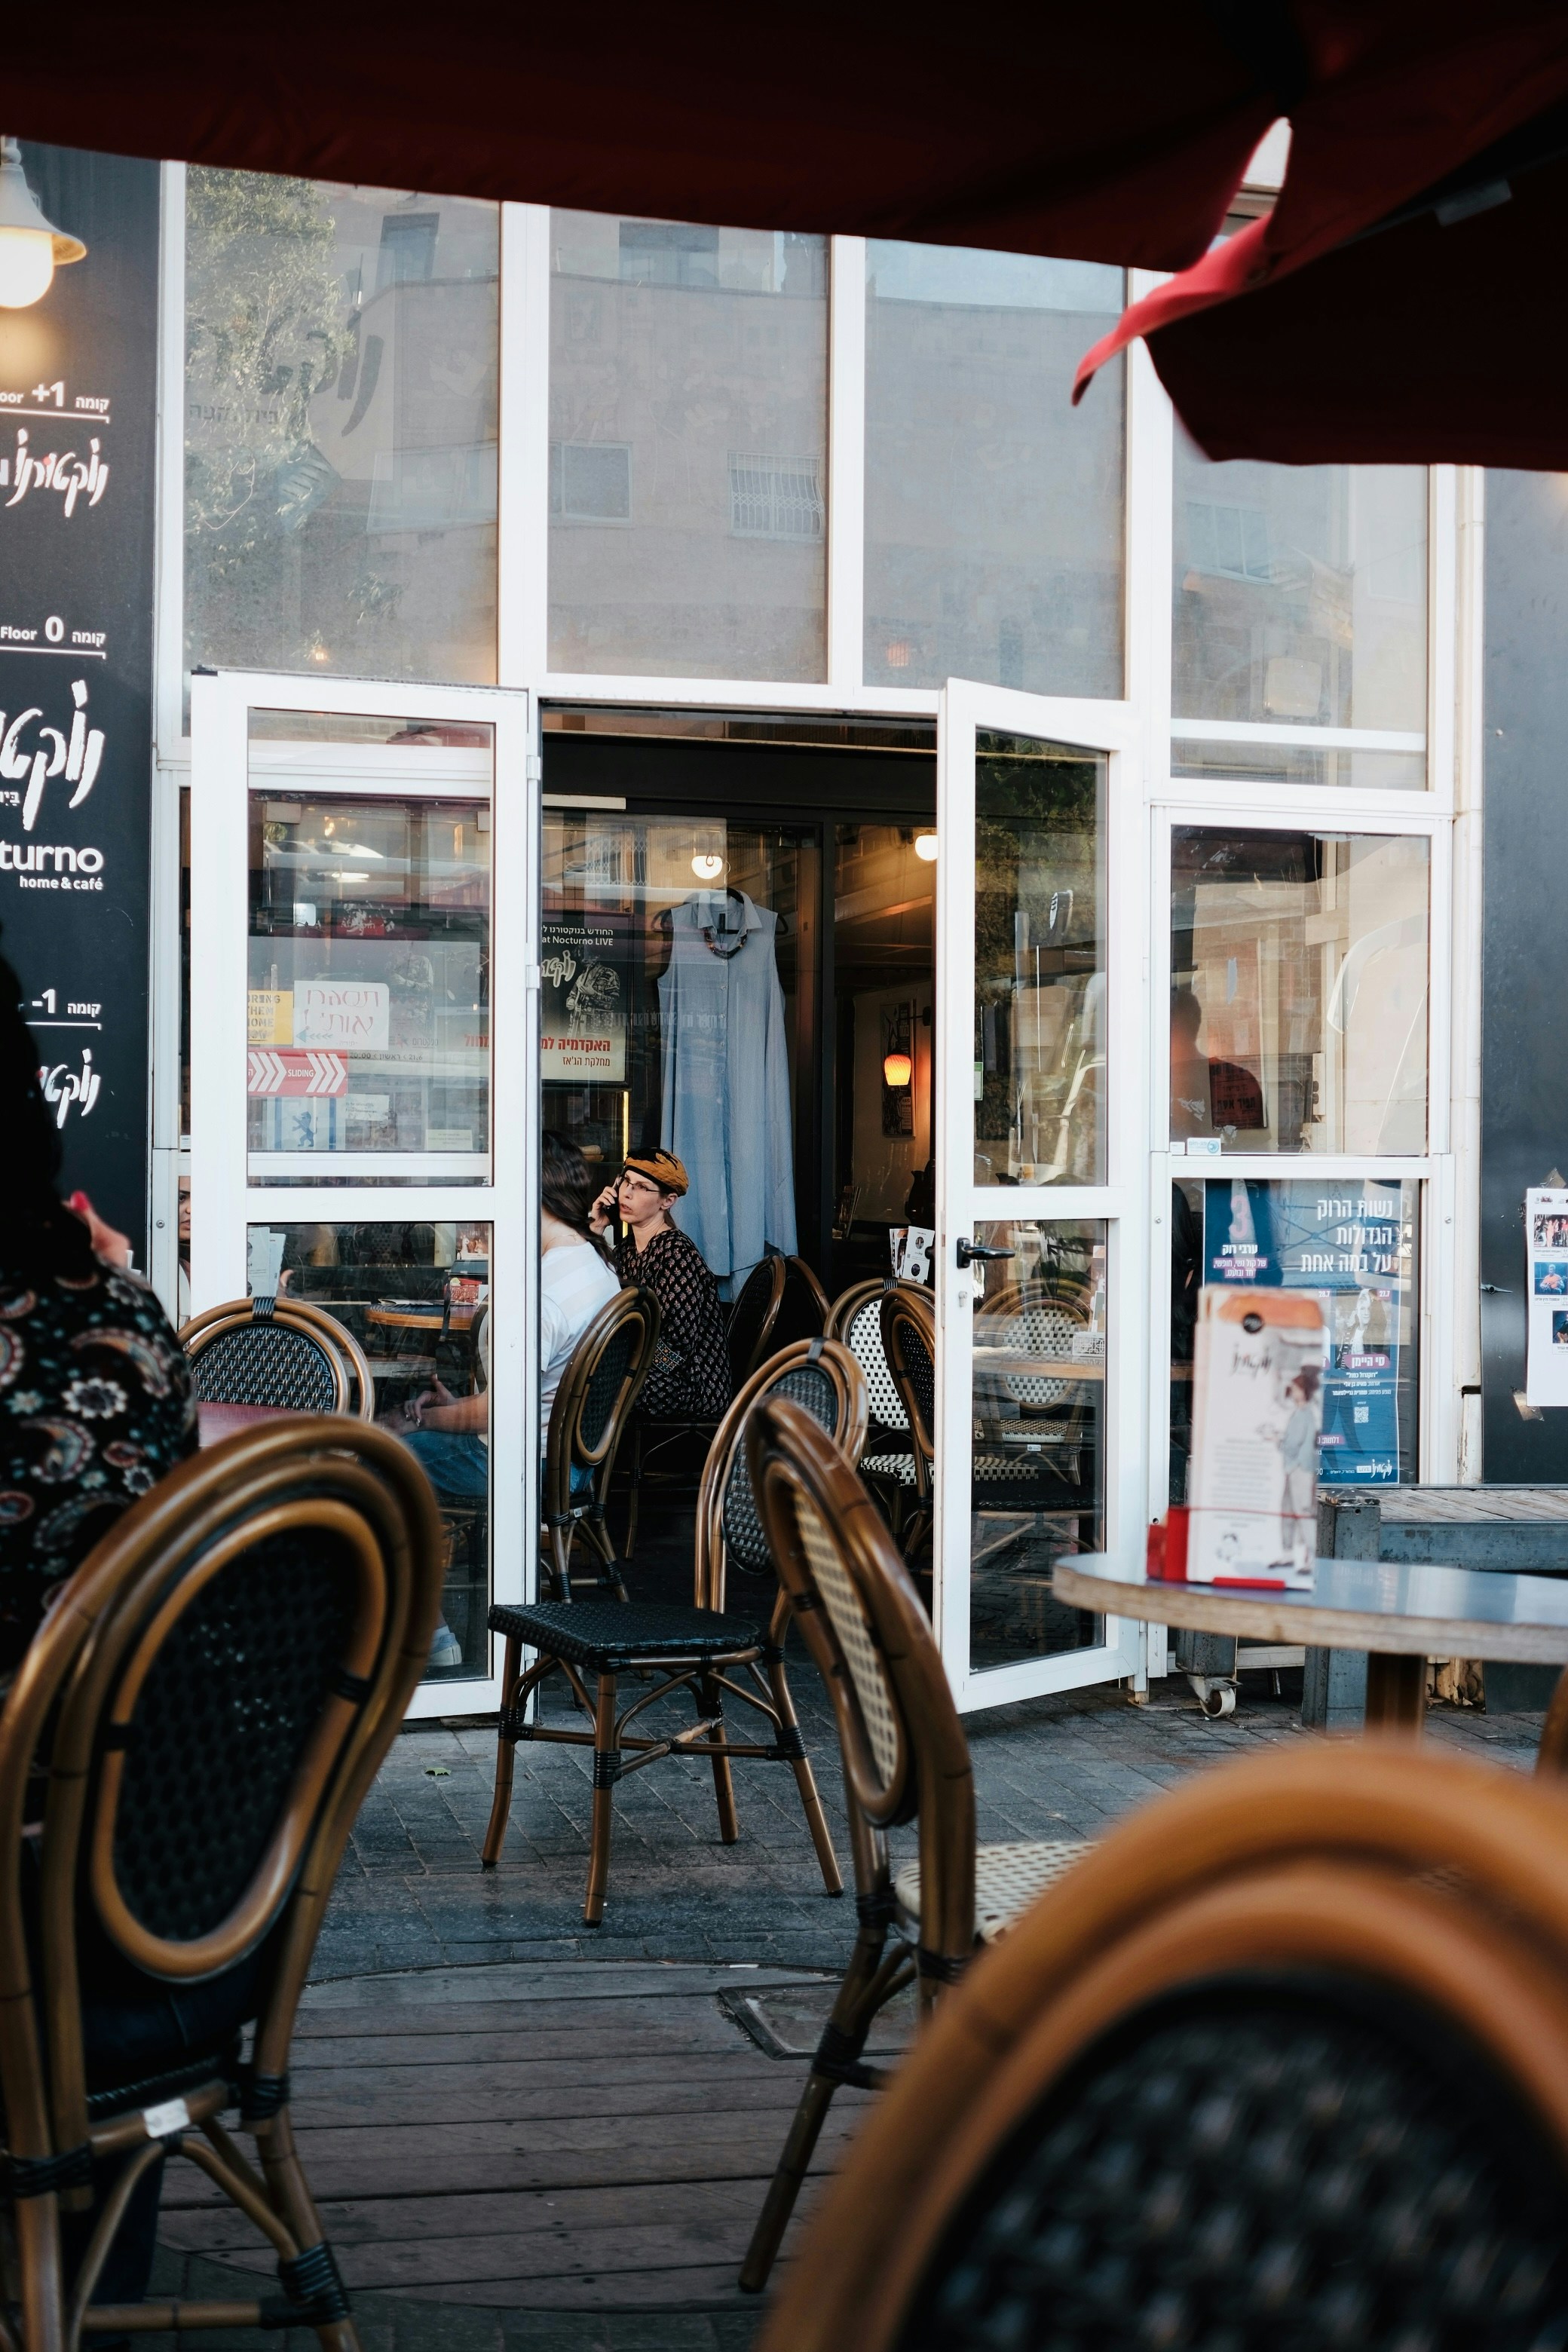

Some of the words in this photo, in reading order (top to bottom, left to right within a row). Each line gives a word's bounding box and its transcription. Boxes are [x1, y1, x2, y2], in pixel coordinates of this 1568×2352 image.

[32, 381, 64, 407] +1
[75, 396, 109, 413] קומה
[0, 626, 38, 640] Floor
[45, 616, 64, 642] 0
[72, 631, 106, 648] קומה
[20, 875, 59, 889] home
[73, 877, 103, 890] café
[550, 926, 586, 935] בנוקטורנו
[542, 936, 550, 944] at
[553, 936, 593, 945] Nocturno
[595, 938, 614, 946] LIVE
[32, 989, 56, 1014] -1
[67, 1003, 102, 1018] קומה
[248, 1006, 273, 1015] HEM
[558, 1039, 611, 1052] האקדמיה
[584, 1057, 611, 1067] מחלקת
[287, 1069, 314, 1077] SLIDING
[1317, 1199, 1352, 1220] הרוק
[1357, 1199, 1393, 1217] נשות
[1229, 1195, 1249, 1239] 3
[1336, 1227, 1392, 1245] הגדולות
[1222, 1245, 1235, 1255] רוק
[1236, 1245, 1257, 1254] ערבי
[1246, 1258, 1257, 1268] קול
[1257, 1258, 1266, 1267] של
[1300, 1254, 1334, 1272] אחת
[1339, 1254, 1368, 1272] במה
[1373, 1252, 1392, 1272] על
[1352, 1357, 1373, 1368] היימן
[1375, 1357, 1385, 1366] סי
